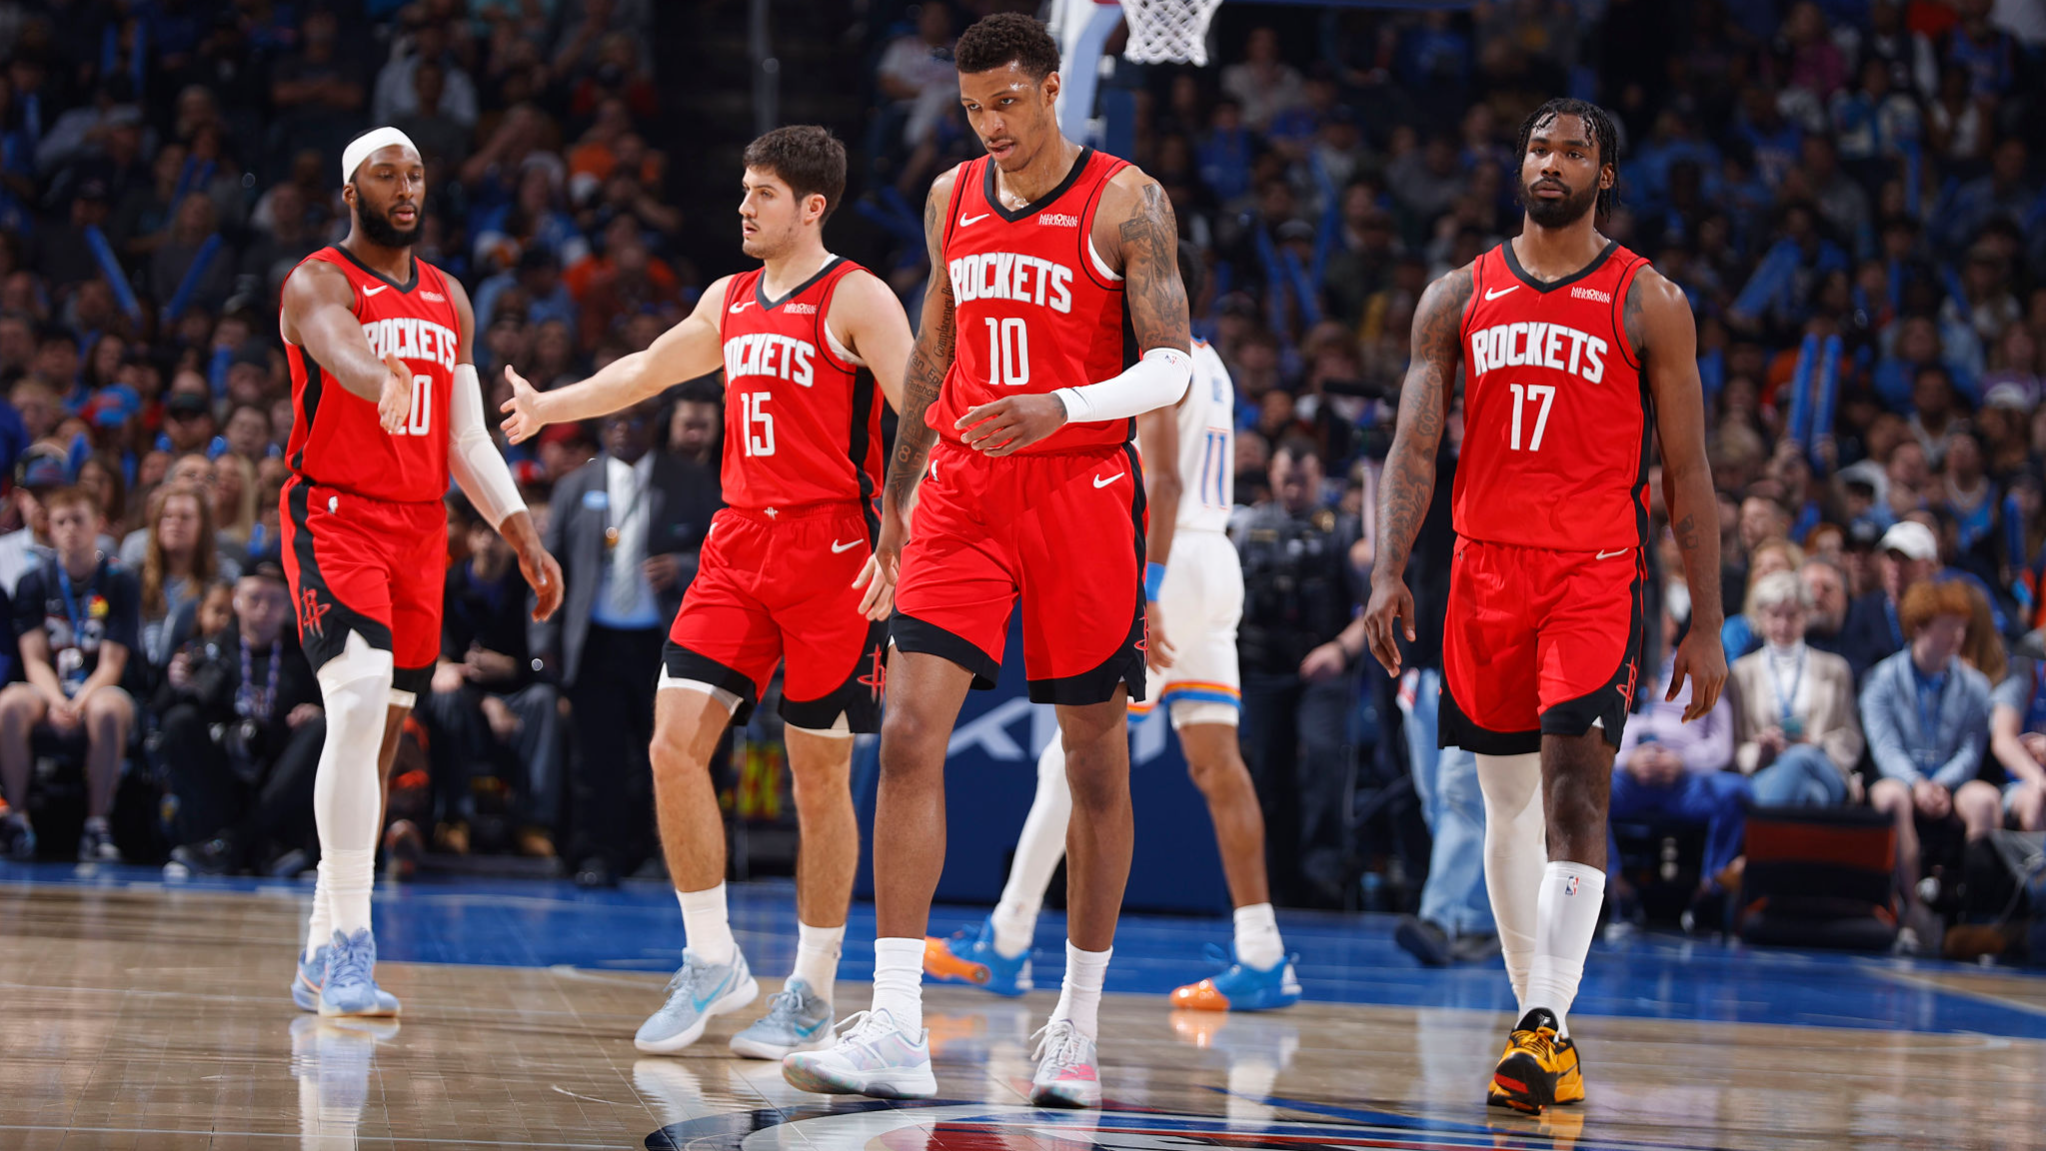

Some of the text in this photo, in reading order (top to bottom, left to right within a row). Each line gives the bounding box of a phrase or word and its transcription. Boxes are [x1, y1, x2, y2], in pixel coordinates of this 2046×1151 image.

[950, 252, 1073, 314] ROCKETS
[723, 332, 815, 388] OCKETS
[984, 317, 1030, 386] 10
[1471, 321, 1608, 384] ROCKETS
[388, 374, 433, 436] 0
[740, 391, 775, 457] 15
[1510, 383, 1556, 452] 17
[1201, 426, 1230, 511] 11
